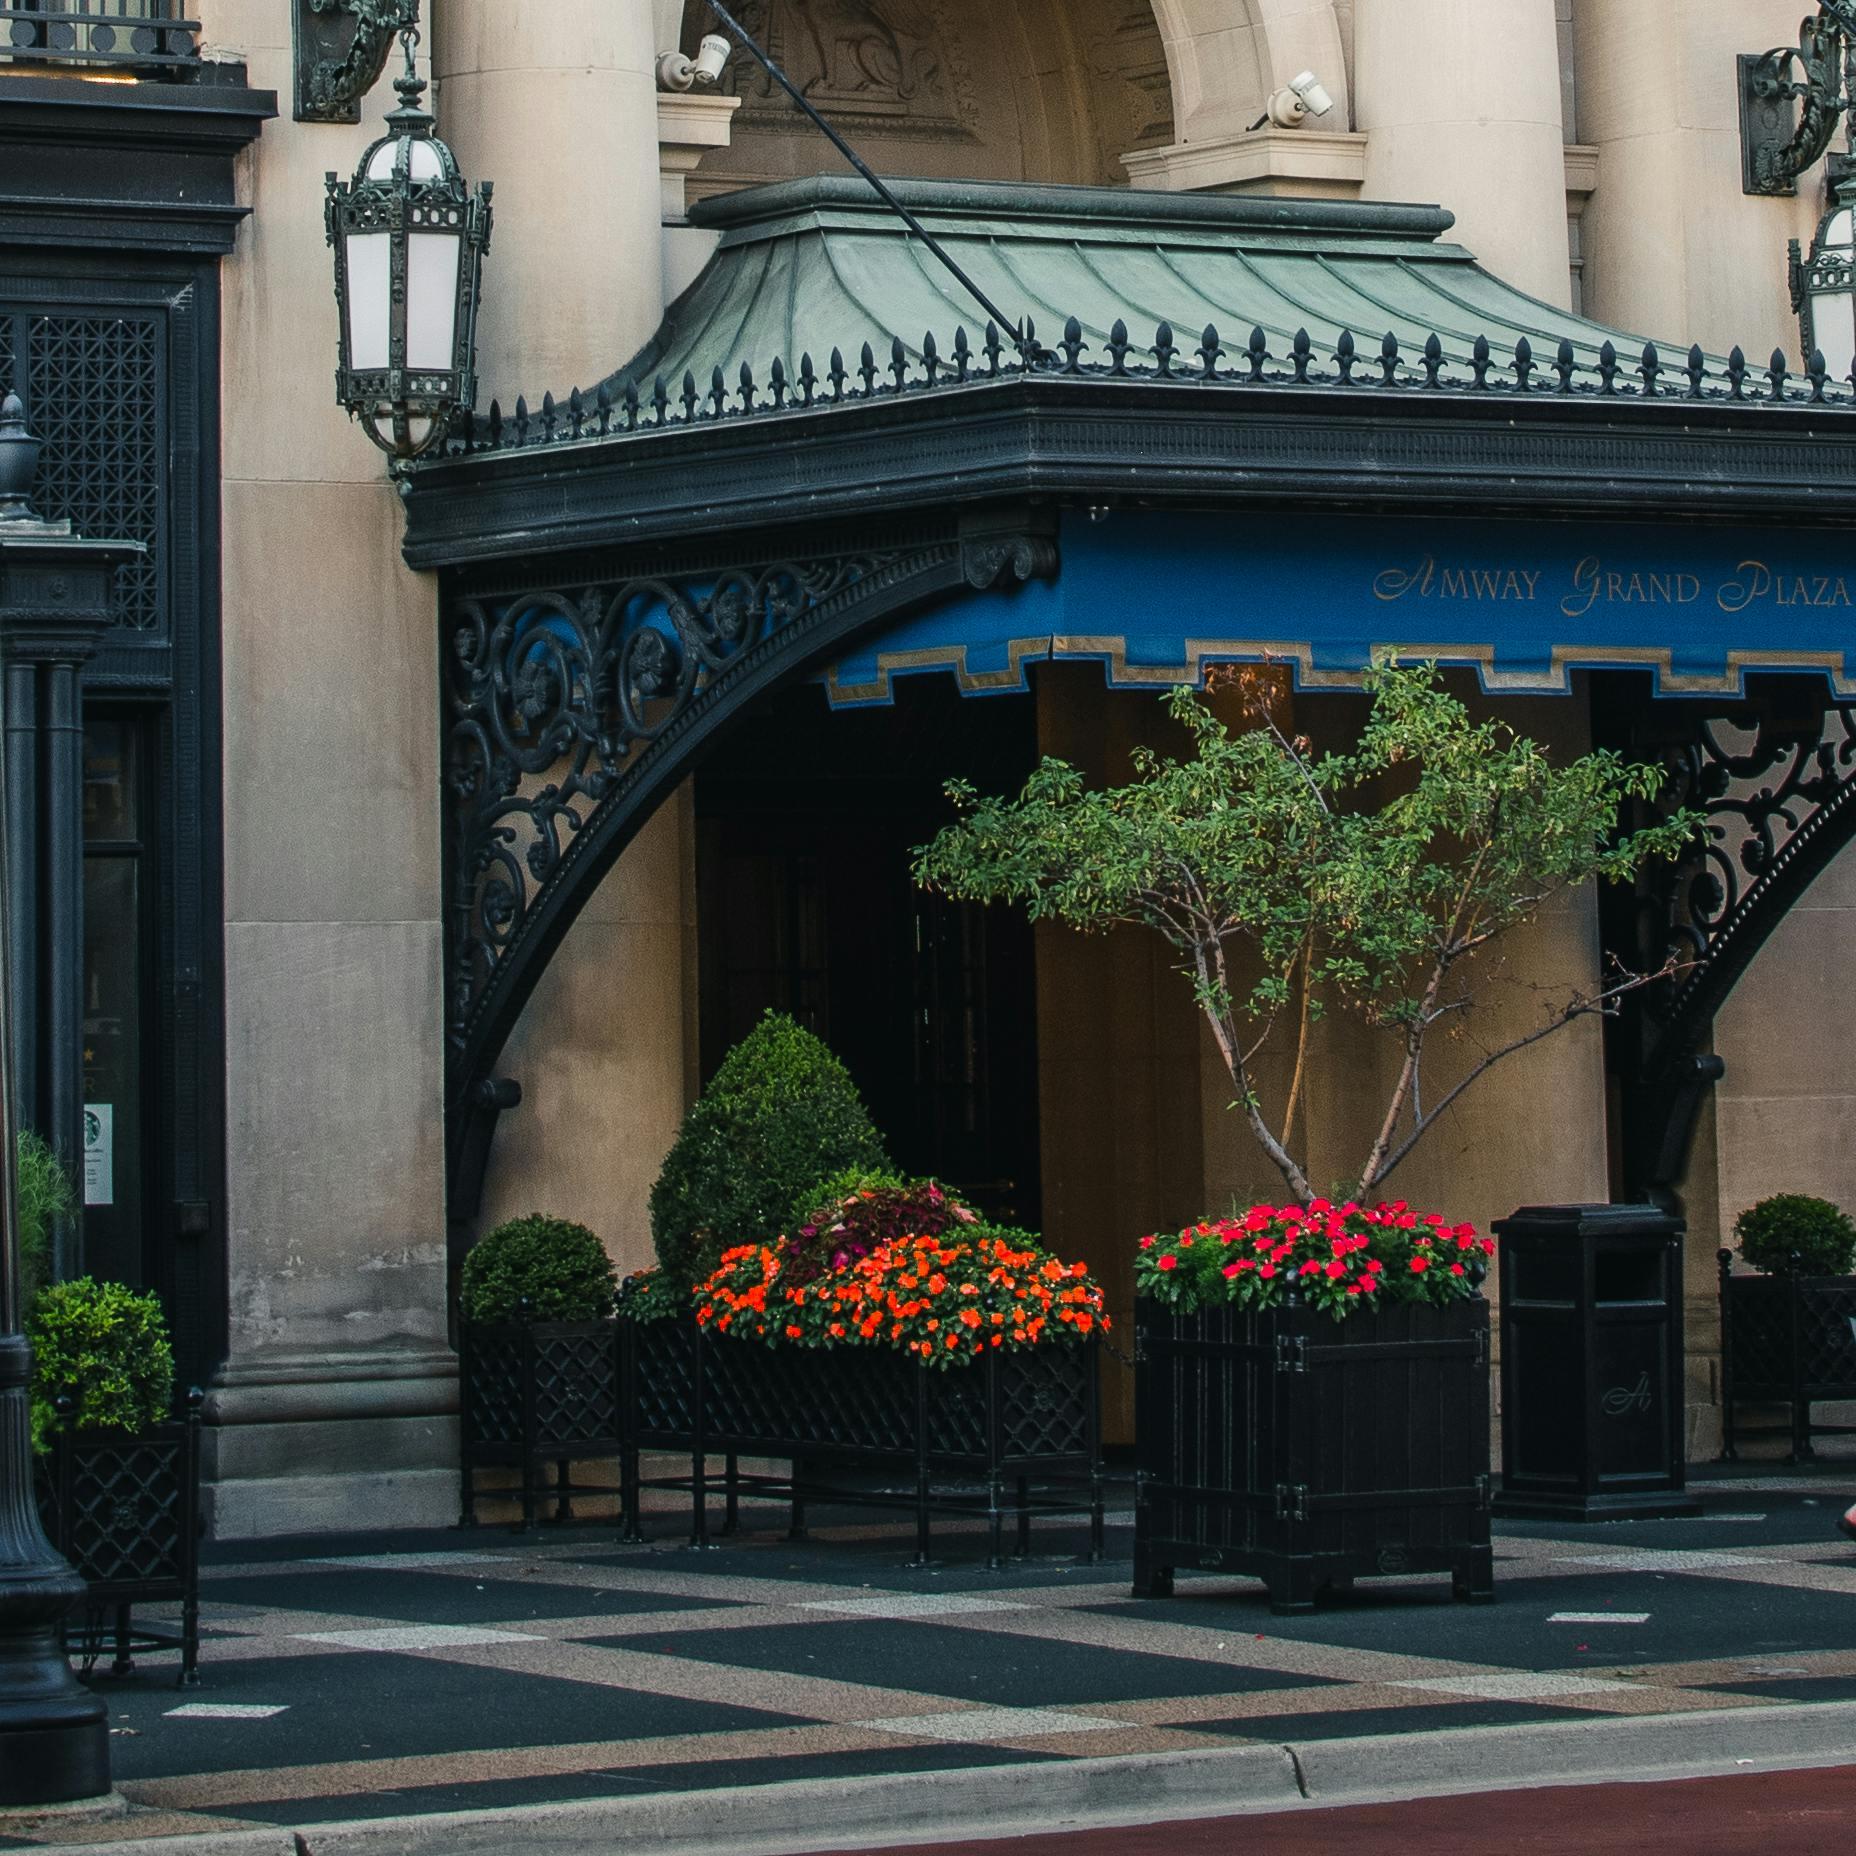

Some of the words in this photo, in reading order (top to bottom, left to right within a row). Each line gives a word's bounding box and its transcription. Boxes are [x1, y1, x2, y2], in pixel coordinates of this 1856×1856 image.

[1373, 553, 1542, 602] AMWAY
[1560, 555, 1701, 617] GRAND
[1716, 560, 1854, 613] PLAZA
